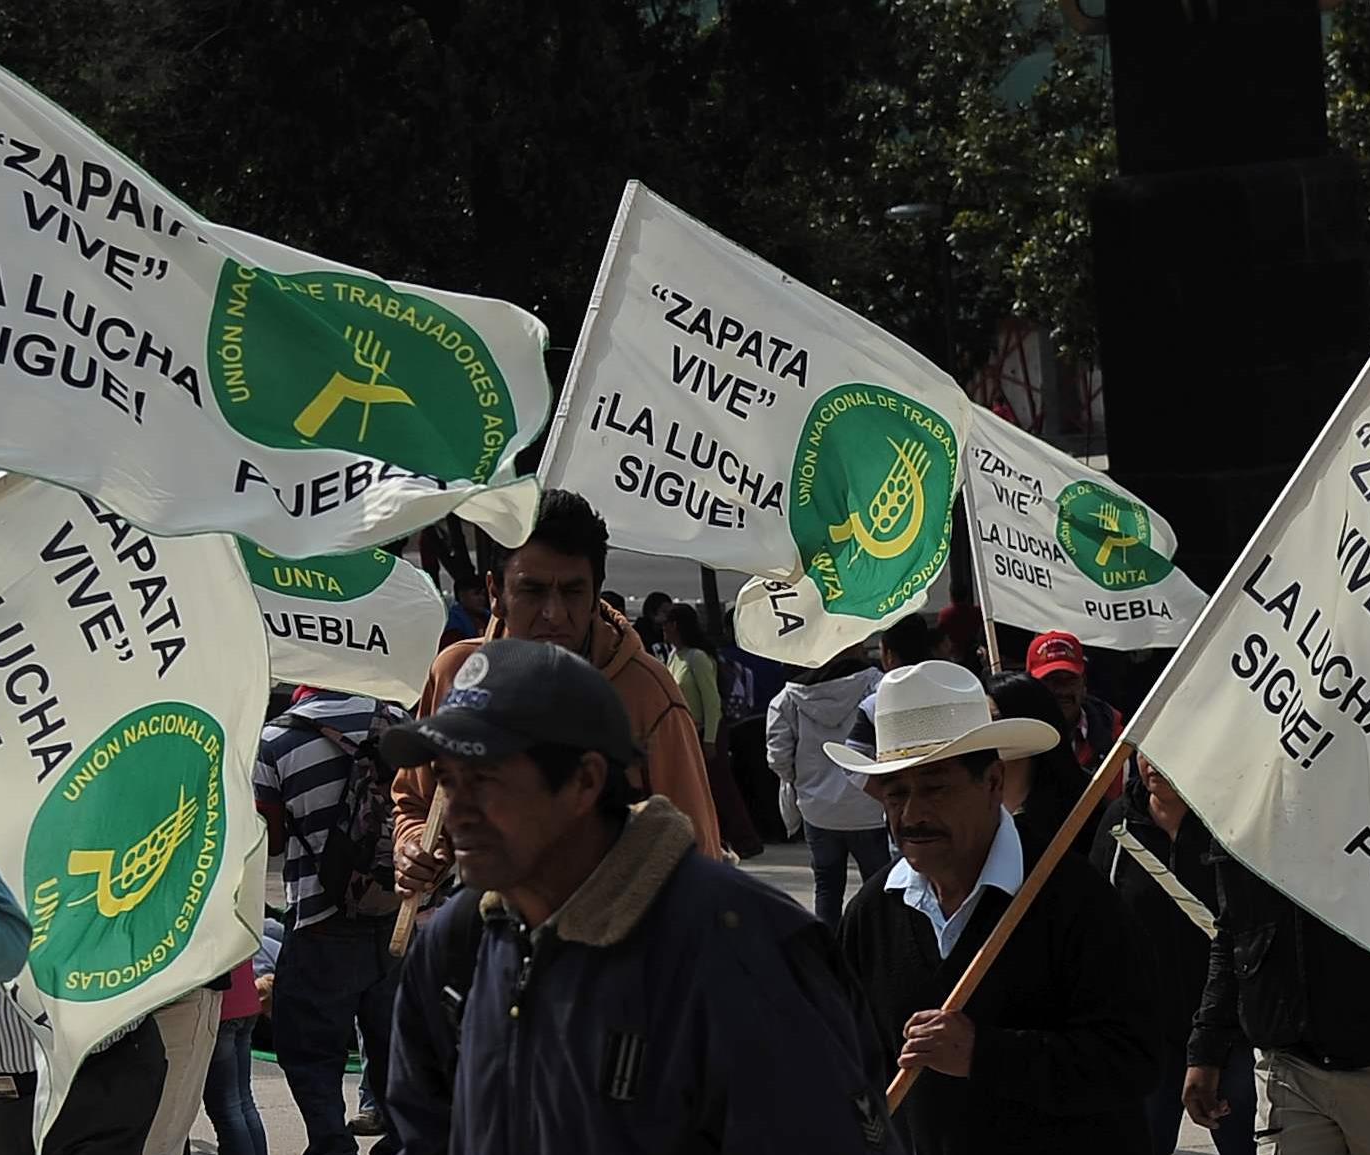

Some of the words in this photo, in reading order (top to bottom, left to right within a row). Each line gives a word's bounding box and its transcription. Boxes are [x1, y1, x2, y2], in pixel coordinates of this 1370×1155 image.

[23, 190, 168, 291] VIVE”
[25, 274, 203, 409] LUCHA
[217, 324, 251, 403] UNIÓN
[332, 282, 500, 409] TRABAJADORES
[651, 284, 809, 388] “ZAPATA
[672, 345, 776, 419] VIVE”
[590, 393, 654, 447] ¡LA
[664, 421, 784, 516] LUCHA
[799, 449, 819, 508] UNIÓN
[809, 391, 877, 448] NACIONAL
[876, 393, 898, 412] DE
[614, 455, 745, 529] SIGUE!
[273, 566, 345, 597] UNTA
[995, 554, 1053, 589] SIGUE!
[1007, 526, 1067, 564] LUCHA
[1102, 569, 1148, 586] UNTA
[40, 520, 133, 663] VIVE”
[1085, 599, 1173, 622] PUEBLA
[1243, 554, 1302, 632] LA
[264, 612, 390, 655] UEBLA
[122, 714, 204, 747] NACIONAL
[1231, 633, 1334, 770] SIGUE!
[63, 739, 121, 803] UNIÓN
[29, 877, 59, 953] UNTA
[65, 930, 177, 992] AGRICOLAS
